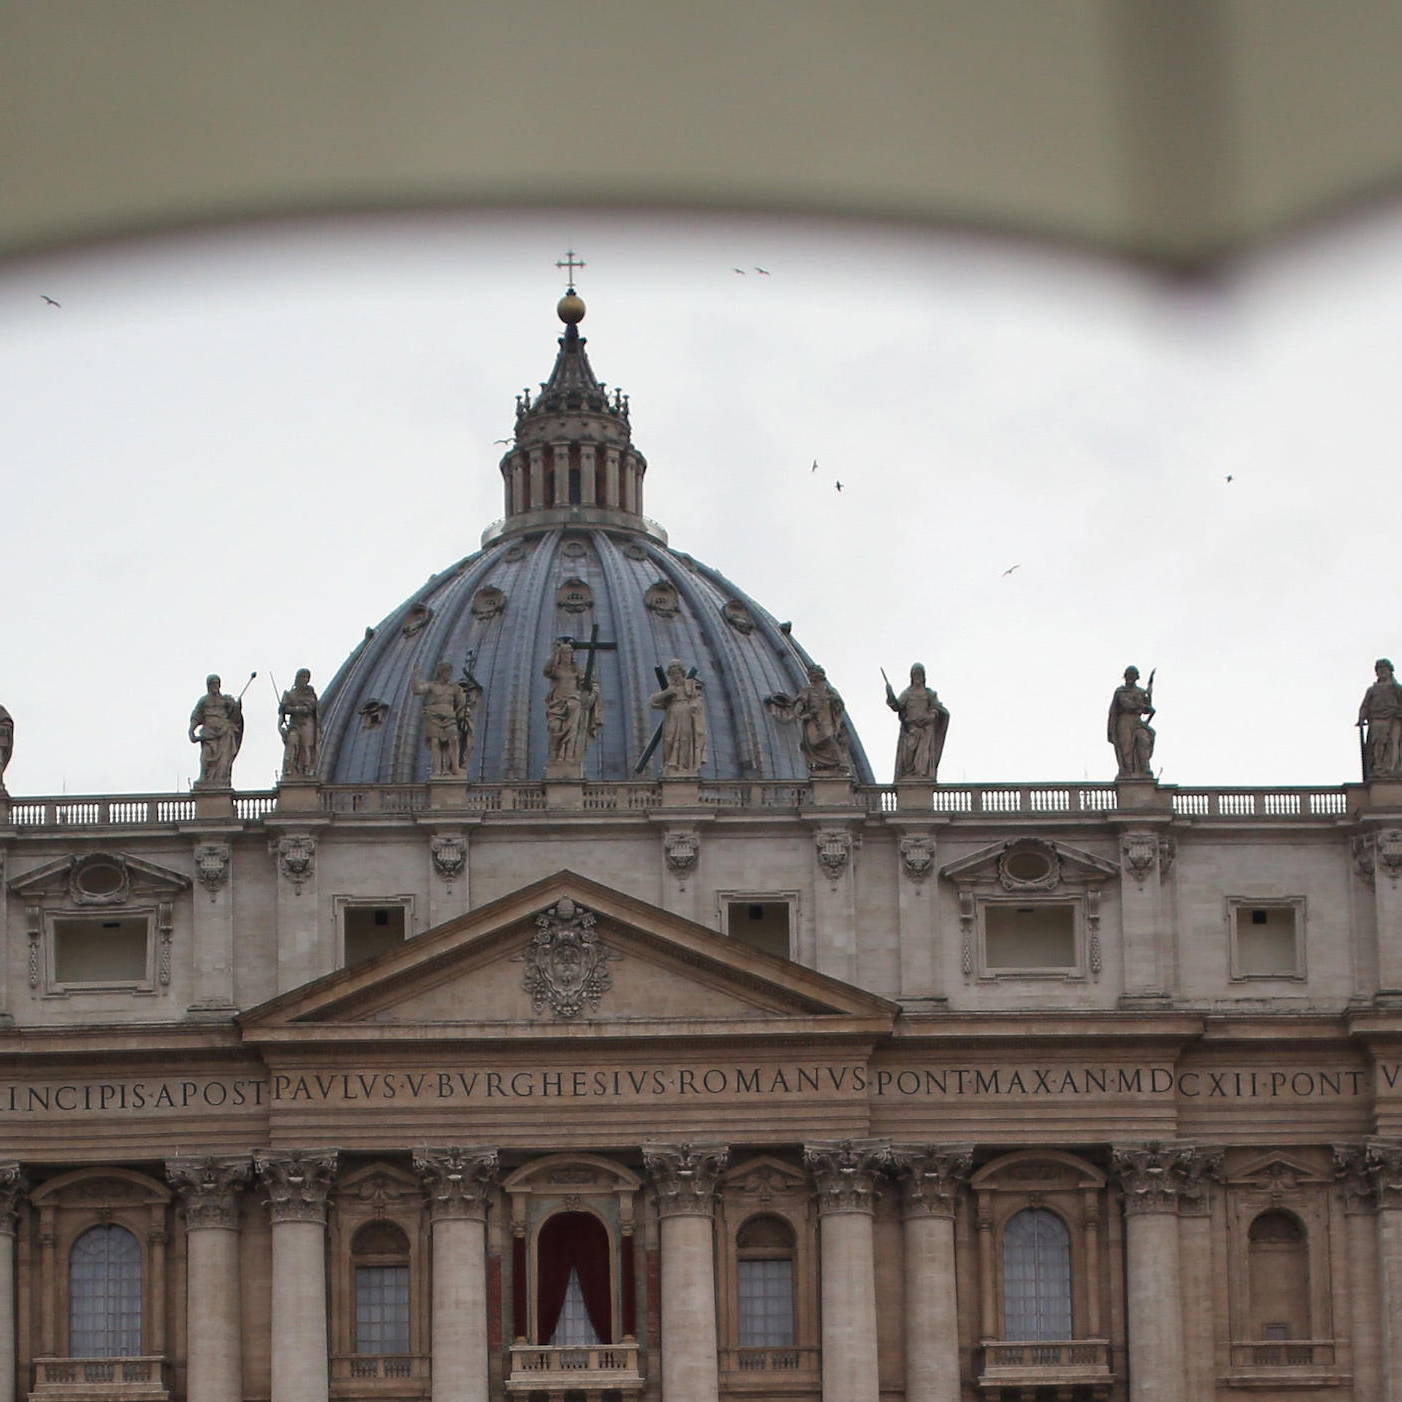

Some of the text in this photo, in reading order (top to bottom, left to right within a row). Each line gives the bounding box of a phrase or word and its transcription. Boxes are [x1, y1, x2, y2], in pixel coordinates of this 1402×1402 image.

[154, 1080, 269, 1107] APOST
[275, 1074, 396, 1100] PAVLVS
[437, 1070, 666, 1099] BVRGHESIVS
[678, 1066, 866, 1095] ROMANVS
